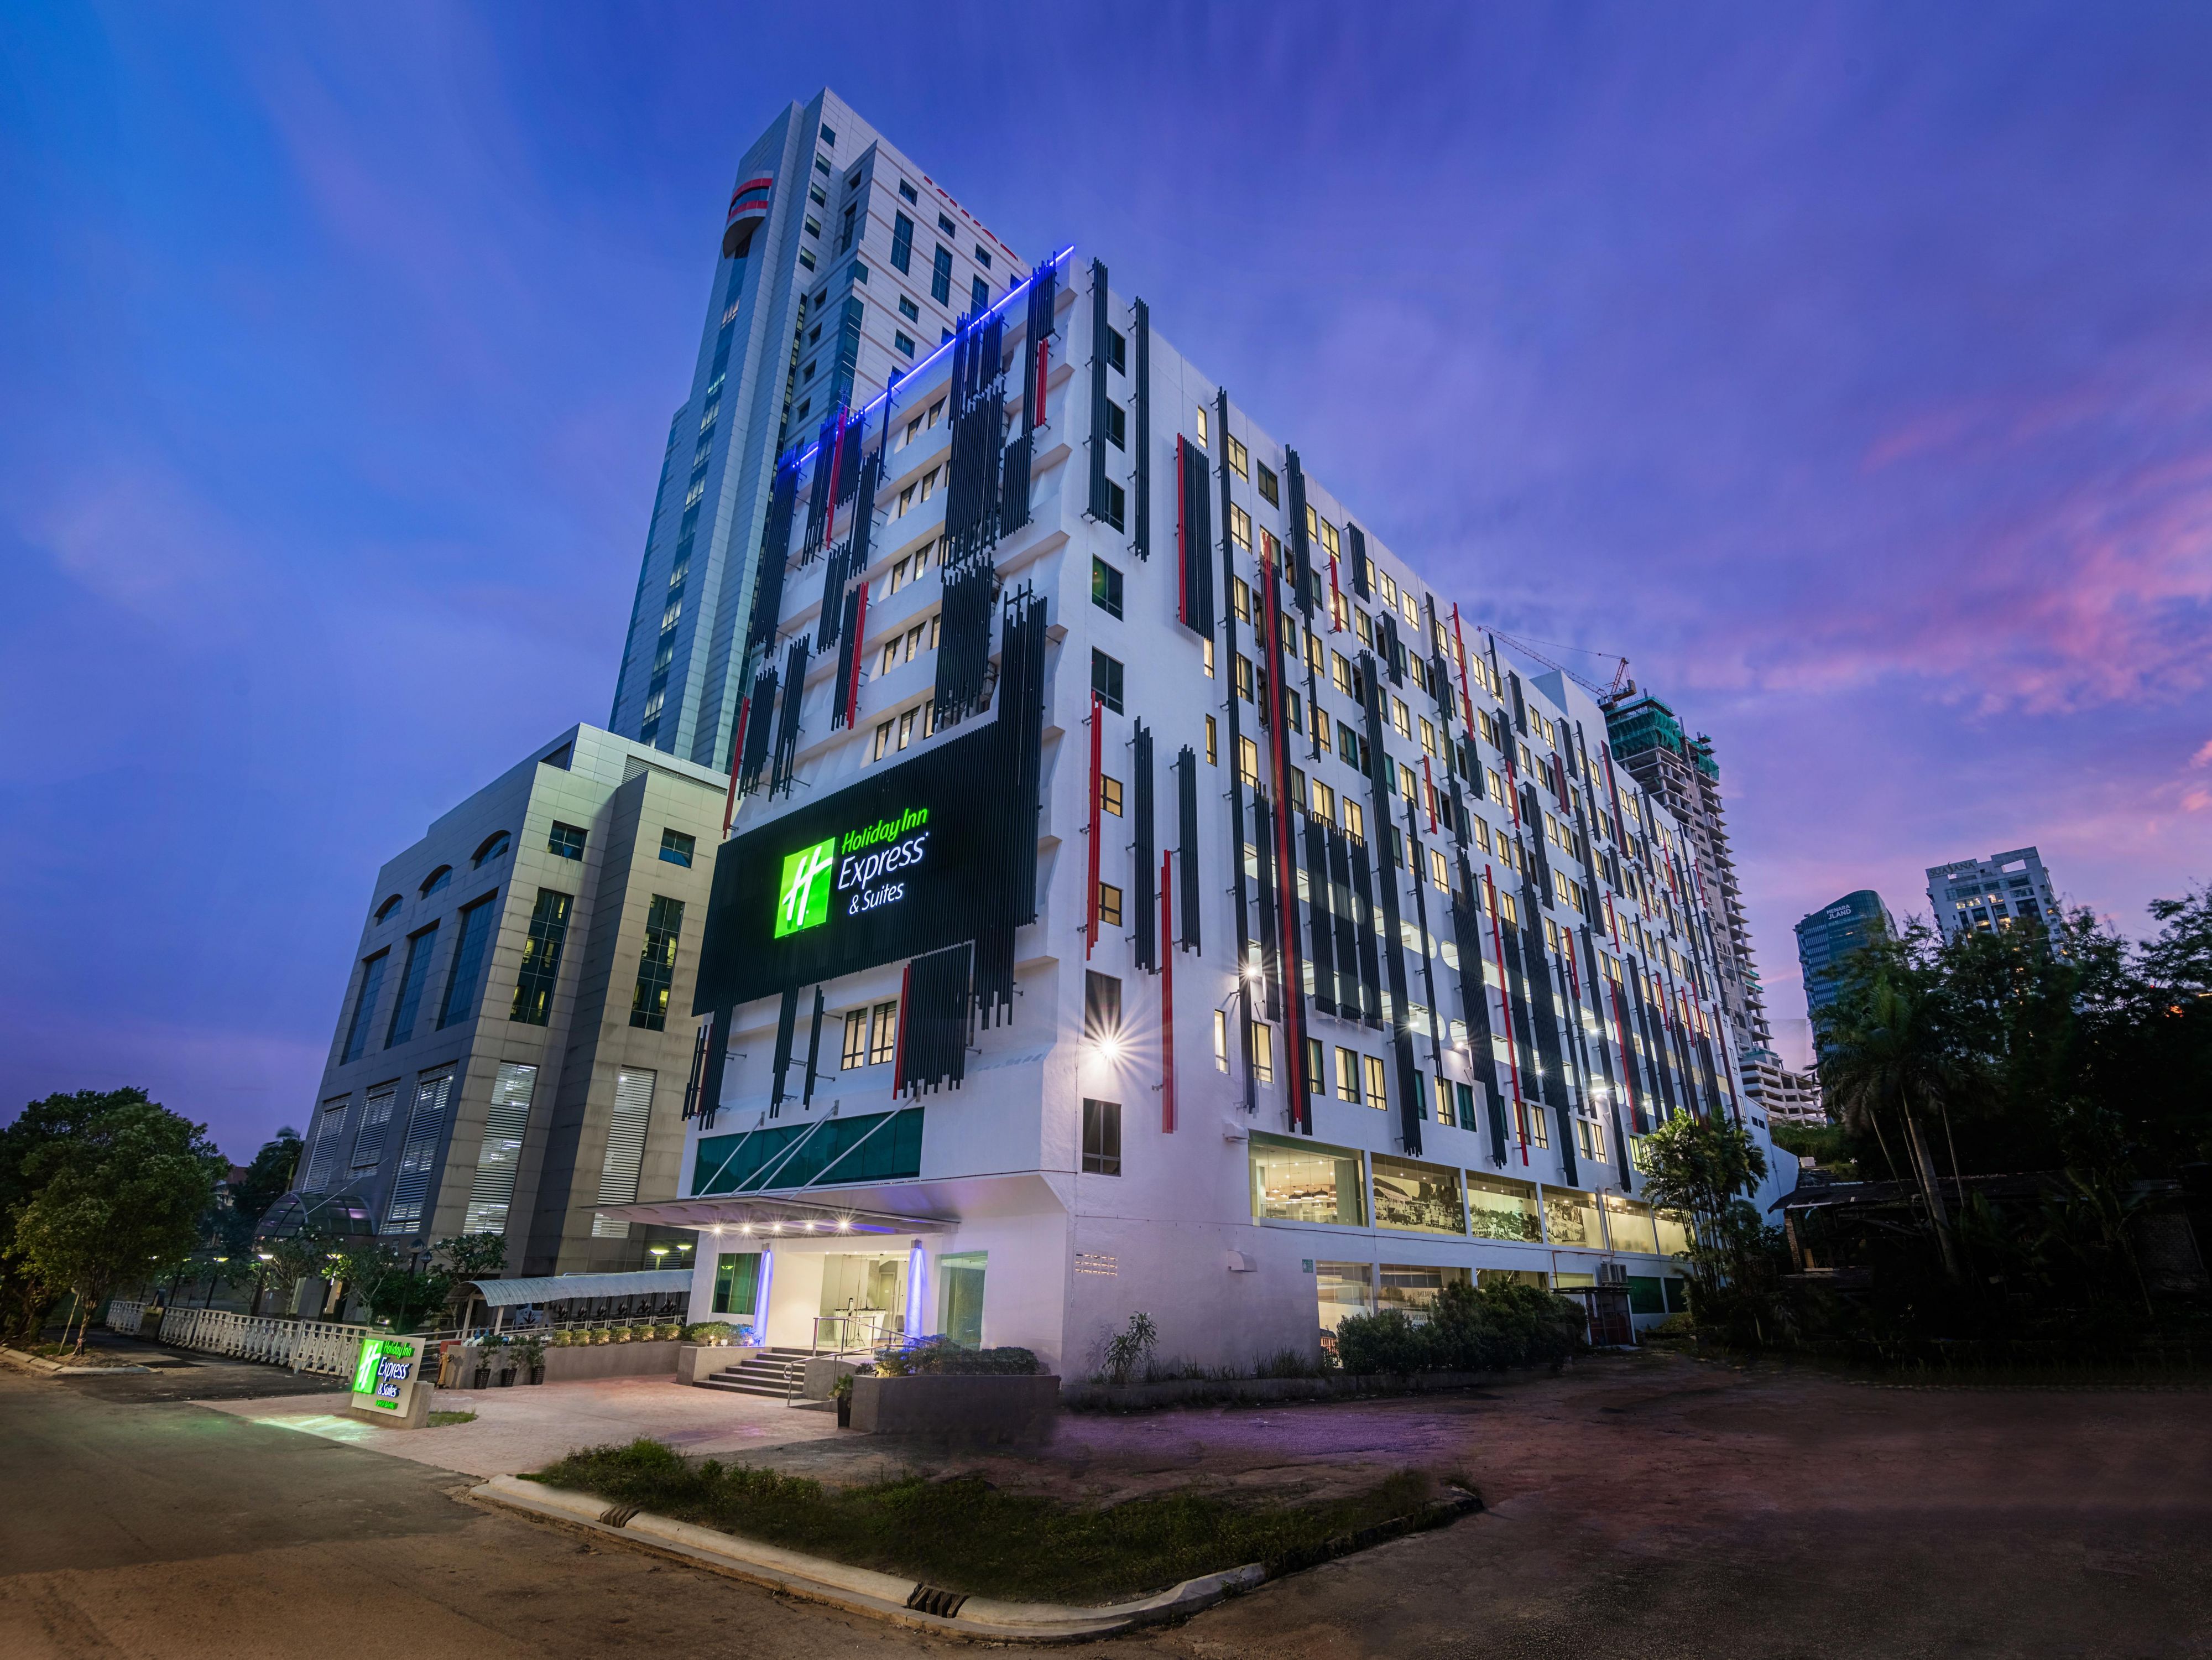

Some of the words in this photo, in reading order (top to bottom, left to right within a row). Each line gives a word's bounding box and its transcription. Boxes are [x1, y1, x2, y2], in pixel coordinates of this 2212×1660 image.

[842, 819, 901, 855] Holiday
[901, 808, 928, 832] Inn
[838, 836, 925, 890] Express
[849, 894, 859, 915] &
[862, 883, 904, 910] Suites
[1826, 904, 1850, 915] MENARA
[1828, 909, 1851, 920] JLAND
[383, 1340, 403, 1359] Holiday
[402, 1342, 412, 1357] Inn
[377, 1356, 409, 1382] Express
[382, 1383, 397, 1397] Suites
